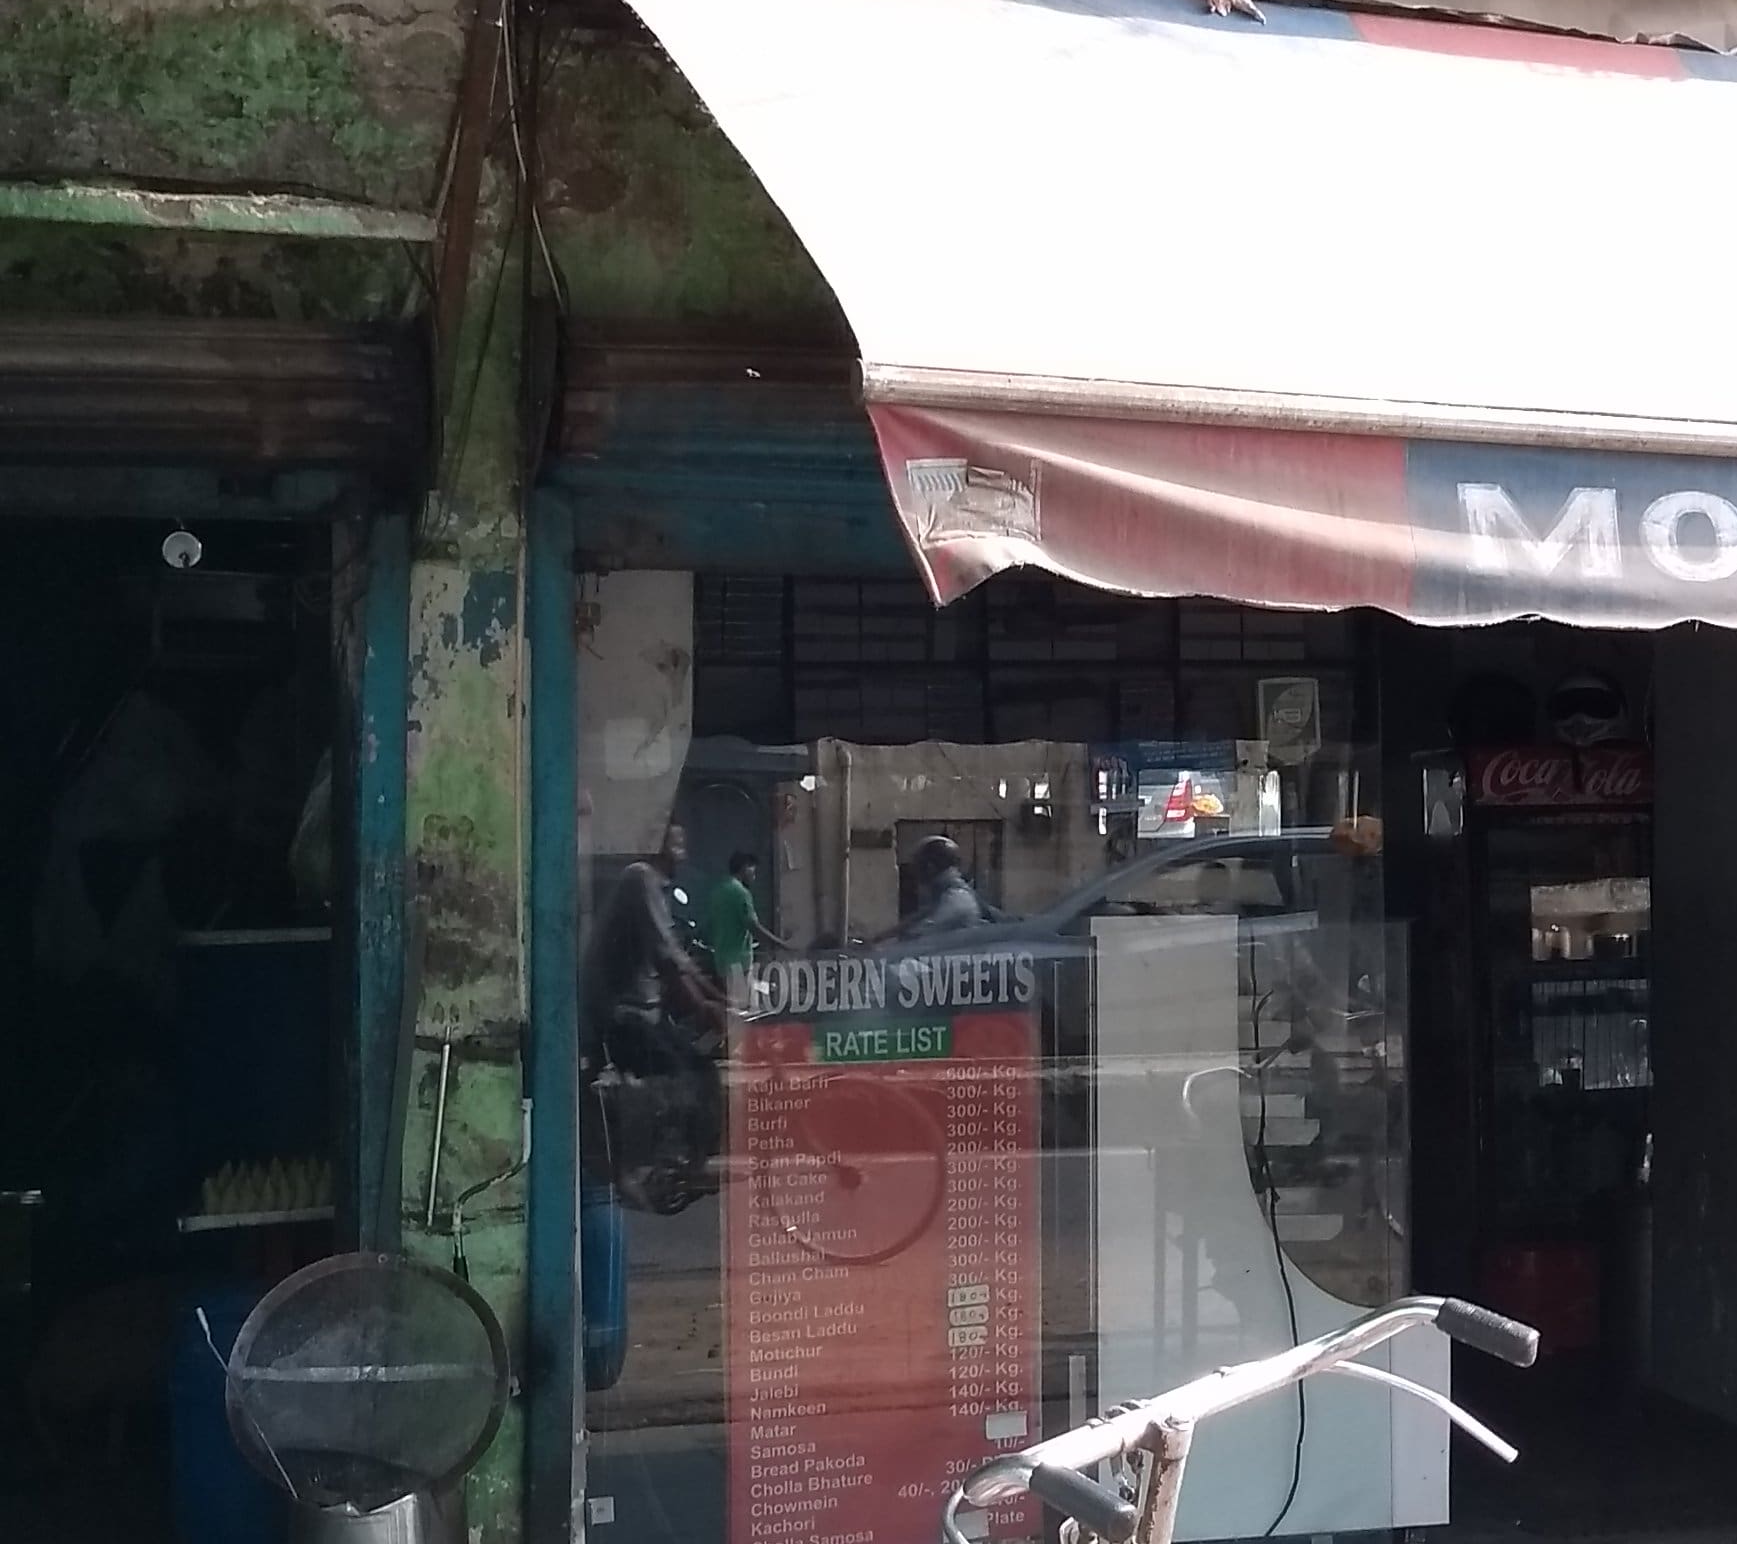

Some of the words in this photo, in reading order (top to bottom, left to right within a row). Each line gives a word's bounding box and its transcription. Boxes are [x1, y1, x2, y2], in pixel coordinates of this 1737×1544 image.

[1482, 750, 1642, 802] Cocaola
[730, 957, 886, 1016] MODERN
[899, 952, 1036, 1007] SWEETS
[826, 1029, 888, 1057] RATE
[896, 1026, 947, 1053] LIST
[947, 1084, 988, 1100] 300/-
[947, 1103, 988, 1118] 300/-
[947, 1121, 988, 1137] 300/-
[748, 1135, 794, 1150] Petha
[947, 1140, 988, 1156] 200/-
[947, 1158, 988, 1174] 300/-
[748, 1174, 782, 1190] Milk
[948, 1177, 988, 1193] 300/-
[748, 1191, 826, 1209] Kalakand
[948, 1197, 989, 1212] 200/-
[948, 1215, 989, 1231] 200/-
[749, 1230, 798, 1247] Gulab
[801, 1228, 857, 1243] Jamun
[948, 1233, 989, 1249] 200/-
[948, 1251, 989, 1268] 300/-
[750, 1270, 796, 1286] Cham
[802, 1266, 849, 1281] Cham
[750, 1289, 801, 1306] Gujiya
[750, 1307, 808, 1325] Boondi
[814, 1302, 865, 1318] Laddu
[750, 1328, 800, 1344] Besan
[807, 1322, 857, 1338] Laddu
[750, 1345, 823, 1363] Motichur
[750, 1365, 799, 1382] Bundi
[949, 1363, 990, 1379] 120/-
[751, 1384, 799, 1402] Jalebi
[949, 1384, 990, 1399] 140/-
[751, 1402, 827, 1420] Namkeen
[949, 1401, 990, 1417] 140/-
[751, 1424, 797, 1440] Matar
[751, 1441, 816, 1460] Samosa
[751, 1461, 800, 1479] Bread
[804, 1453, 866, 1473] Pakoda
[946, 1459, 977, 1475] 30/-
[751, 1480, 803, 1499] Cholla
[808, 1473, 874, 1491] Bhature
[751, 1496, 838, 1517] Chowmein
[751, 1516, 816, 1537] Kachori
